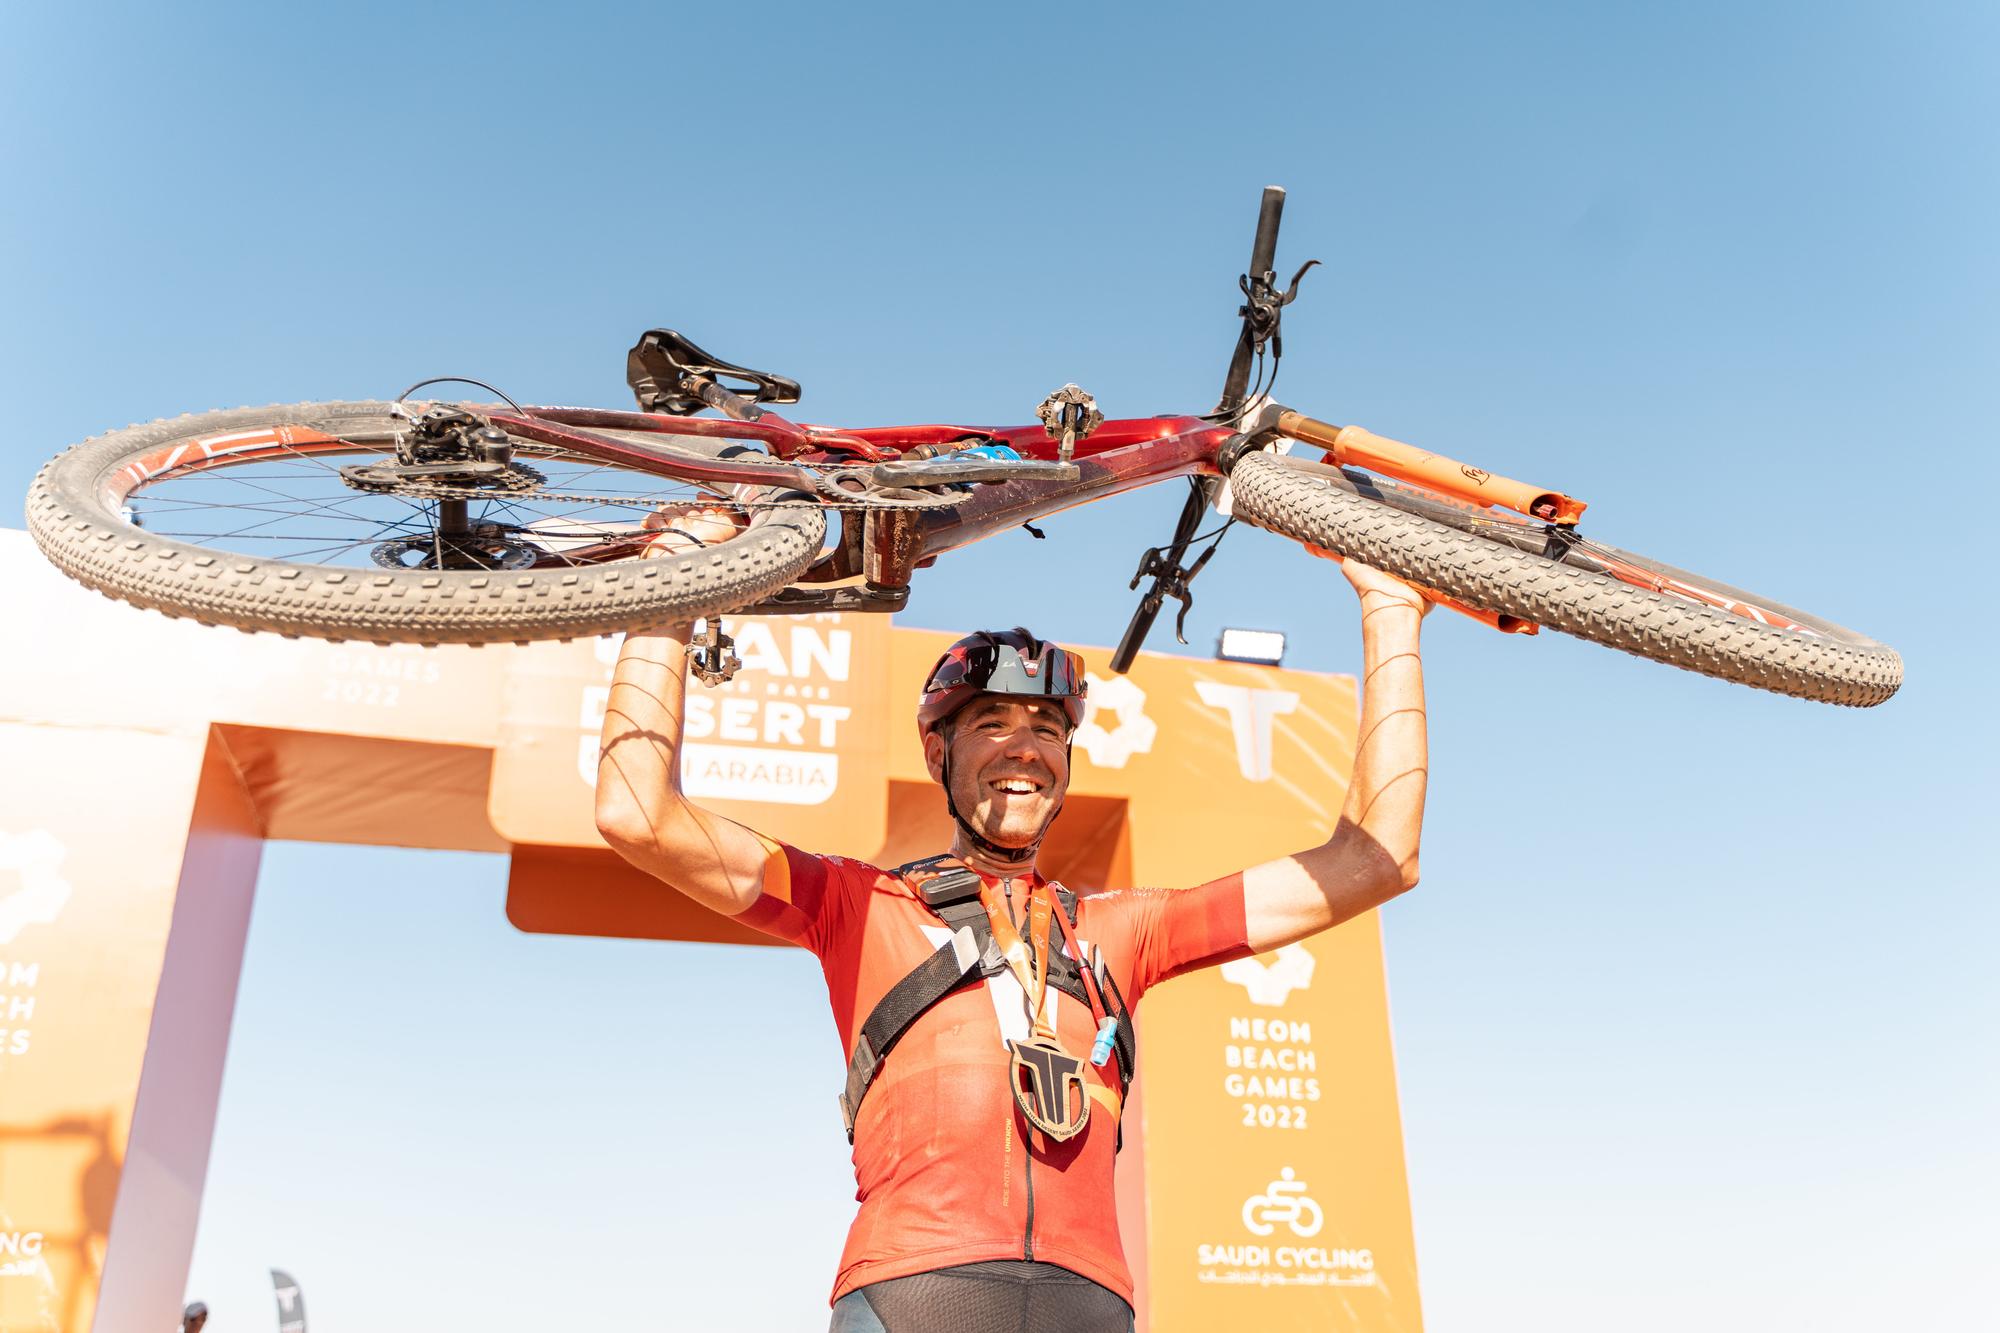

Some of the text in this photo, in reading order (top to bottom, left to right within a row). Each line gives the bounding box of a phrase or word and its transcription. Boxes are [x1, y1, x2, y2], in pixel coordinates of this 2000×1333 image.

[321, 677, 399, 707] 2022
[579, 685, 851, 748] DSERT
[1229, 1016, 1312, 1045] NEOM
[1224, 1044, 1317, 1073] BEACH
[1223, 1073, 1322, 1102] GAMES
[1241, 1102, 1308, 1130] 2022
[1197, 1243, 1375, 1270] SAUDI CYCLING
